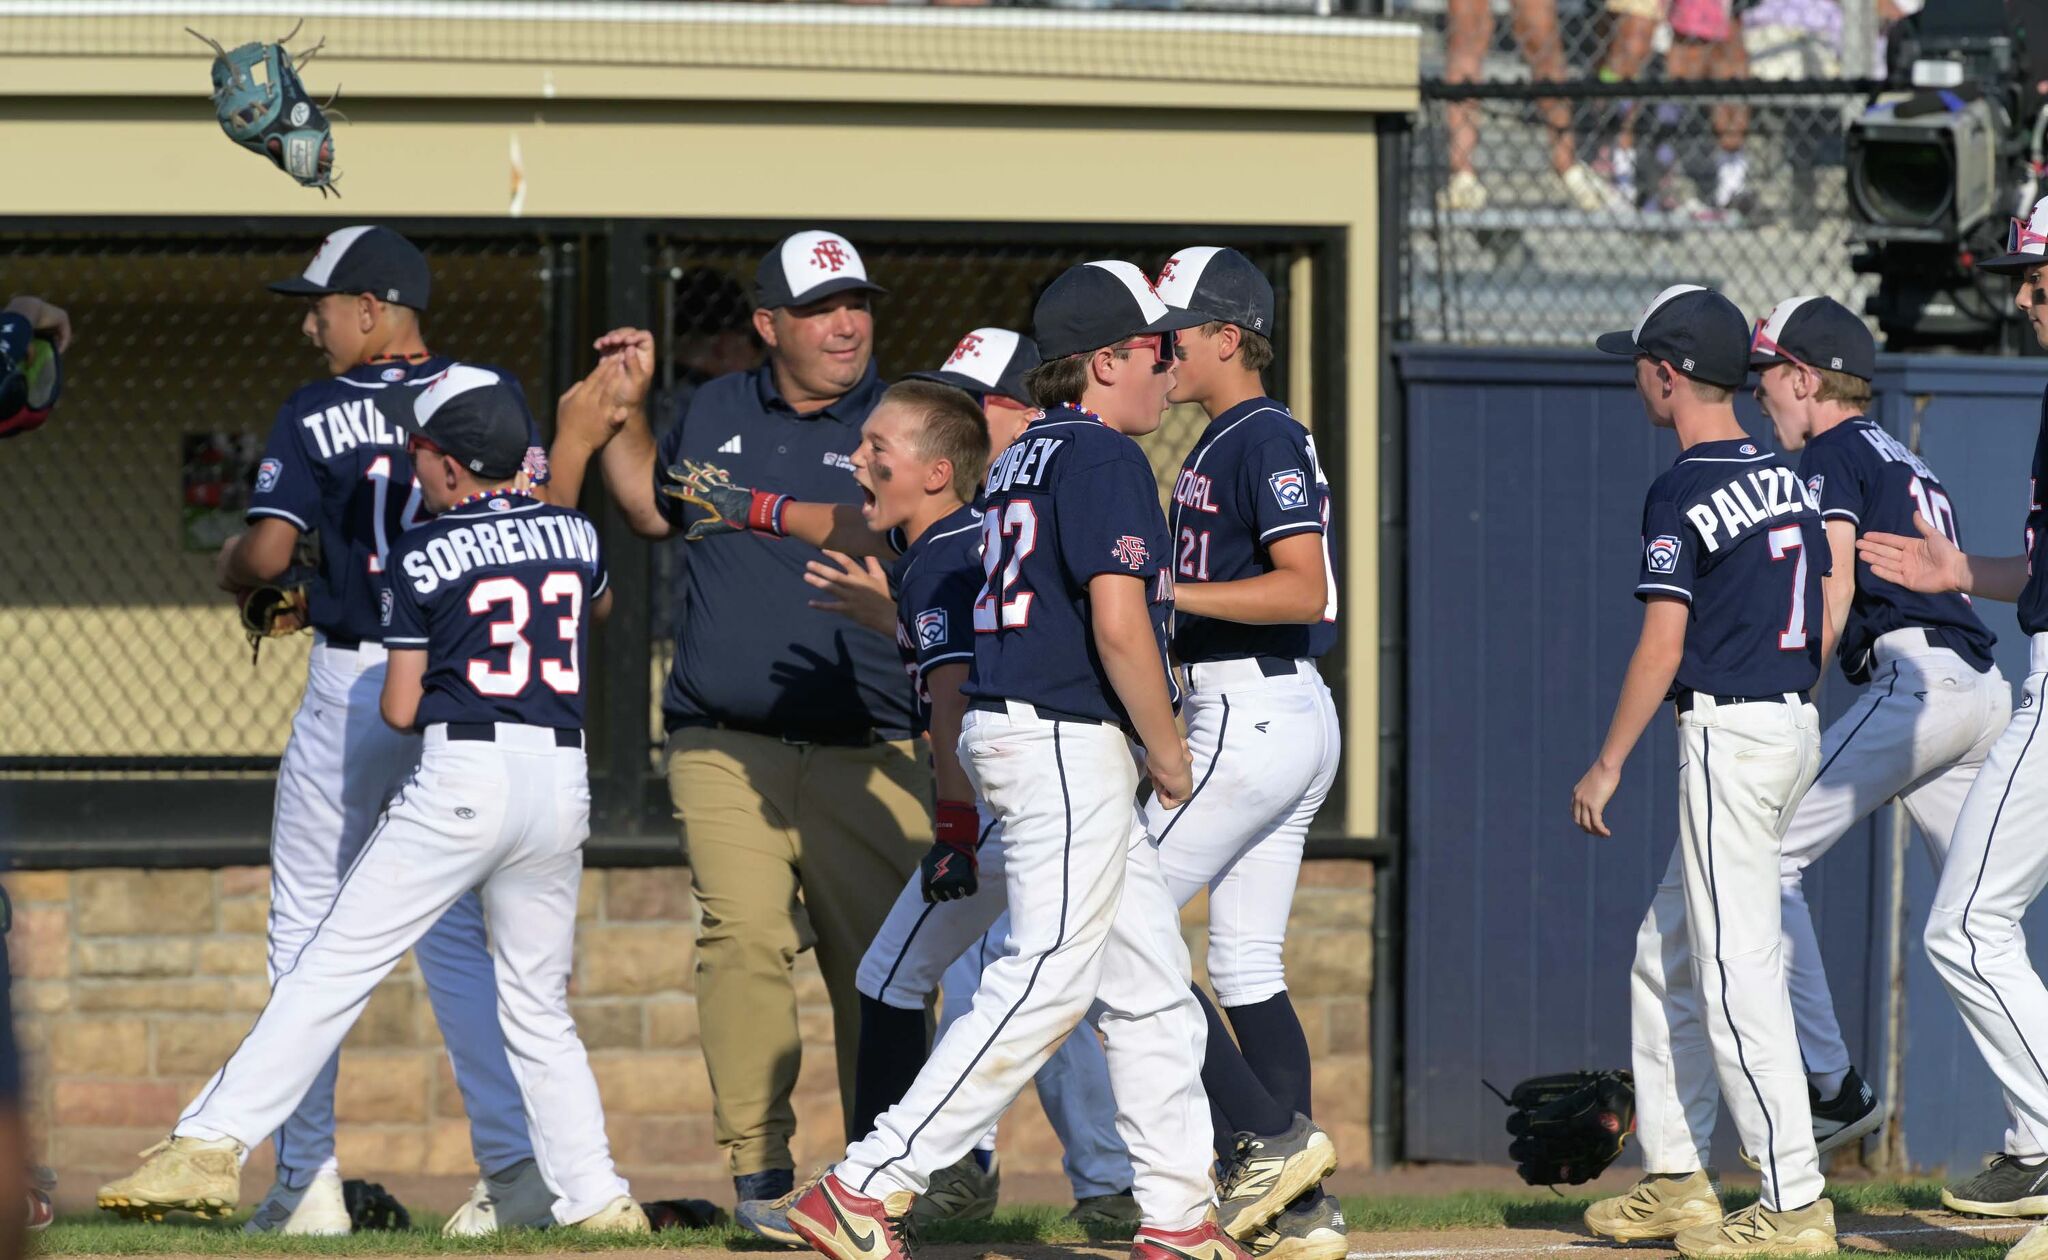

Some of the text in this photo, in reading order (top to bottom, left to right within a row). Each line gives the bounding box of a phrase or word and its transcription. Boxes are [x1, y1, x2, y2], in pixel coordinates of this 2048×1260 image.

[973, 499, 1038, 632] 22
[1179, 525, 1211, 582] 21
[1768, 523, 1808, 651] 7
[467, 571, 583, 697] 33
